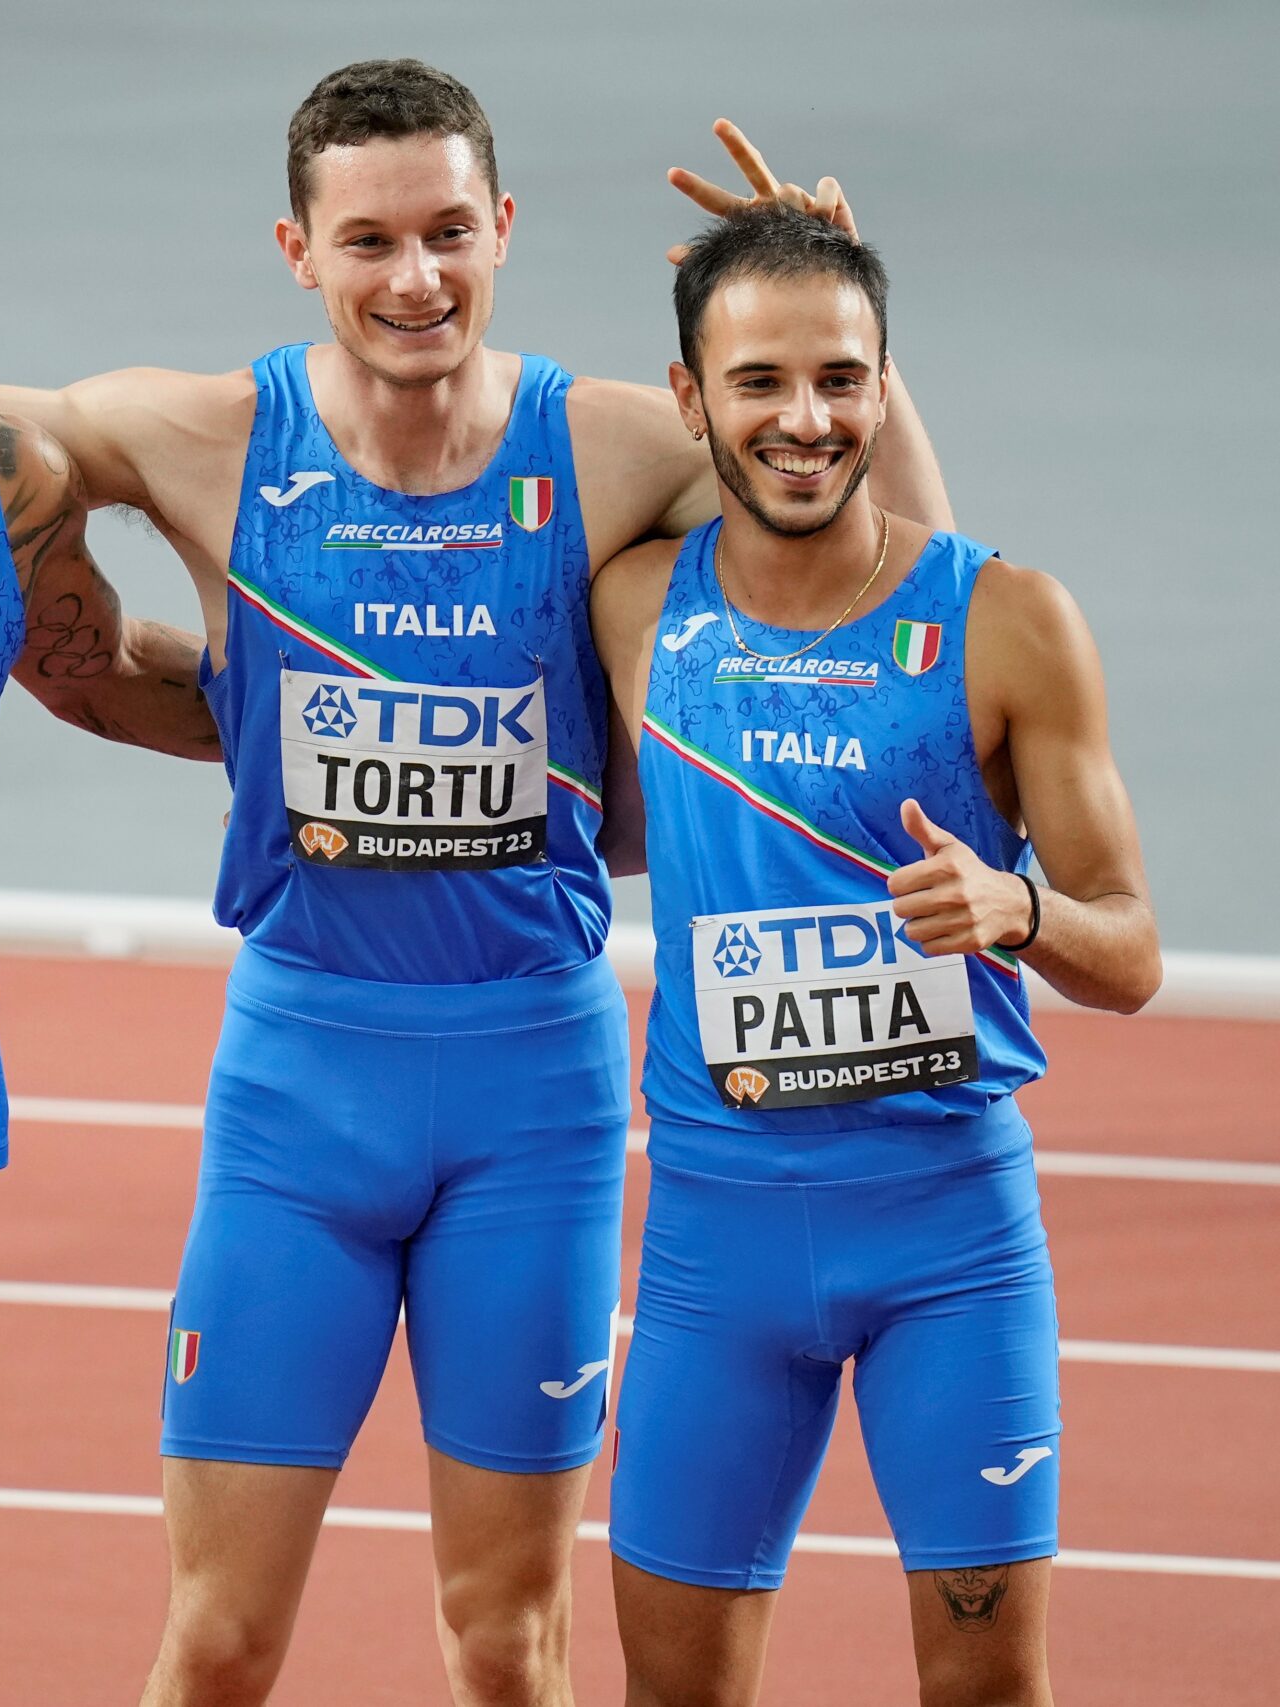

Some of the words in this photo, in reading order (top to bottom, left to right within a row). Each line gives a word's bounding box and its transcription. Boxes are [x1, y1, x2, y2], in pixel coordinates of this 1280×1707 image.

[324, 522, 503, 542] FRECCIAROSSA
[353, 602, 497, 637] ITALIA
[716, 656, 880, 678] FRECCIAROSSA
[357, 688, 536, 748] TDK
[740, 728, 867, 771] ITALIA
[316, 752, 517, 819] TORTU
[357, 834, 504, 858] BUDAPEST
[505, 830, 534, 852] 23
[732, 980, 932, 1054] PATTA
[777, 1055, 925, 1093] BUDAPEST
[928, 1049, 963, 1073] 23
